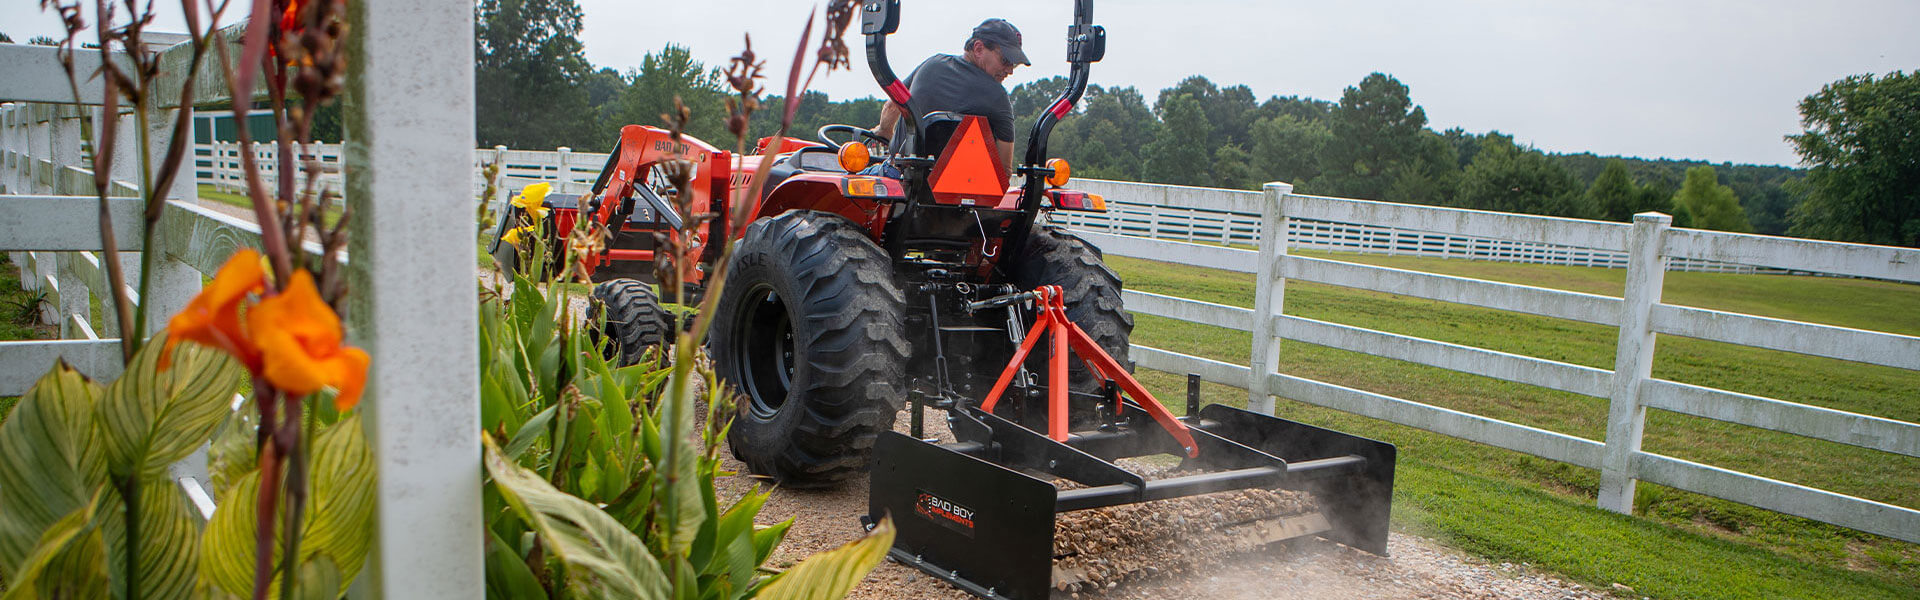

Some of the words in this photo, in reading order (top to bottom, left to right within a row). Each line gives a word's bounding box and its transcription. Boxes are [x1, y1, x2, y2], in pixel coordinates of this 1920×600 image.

[655, 140, 672, 152] BAD
[931, 496, 951, 512] BAD
[953, 505, 974, 520] BOY
[931, 505, 974, 528] IMPLEMENTS
